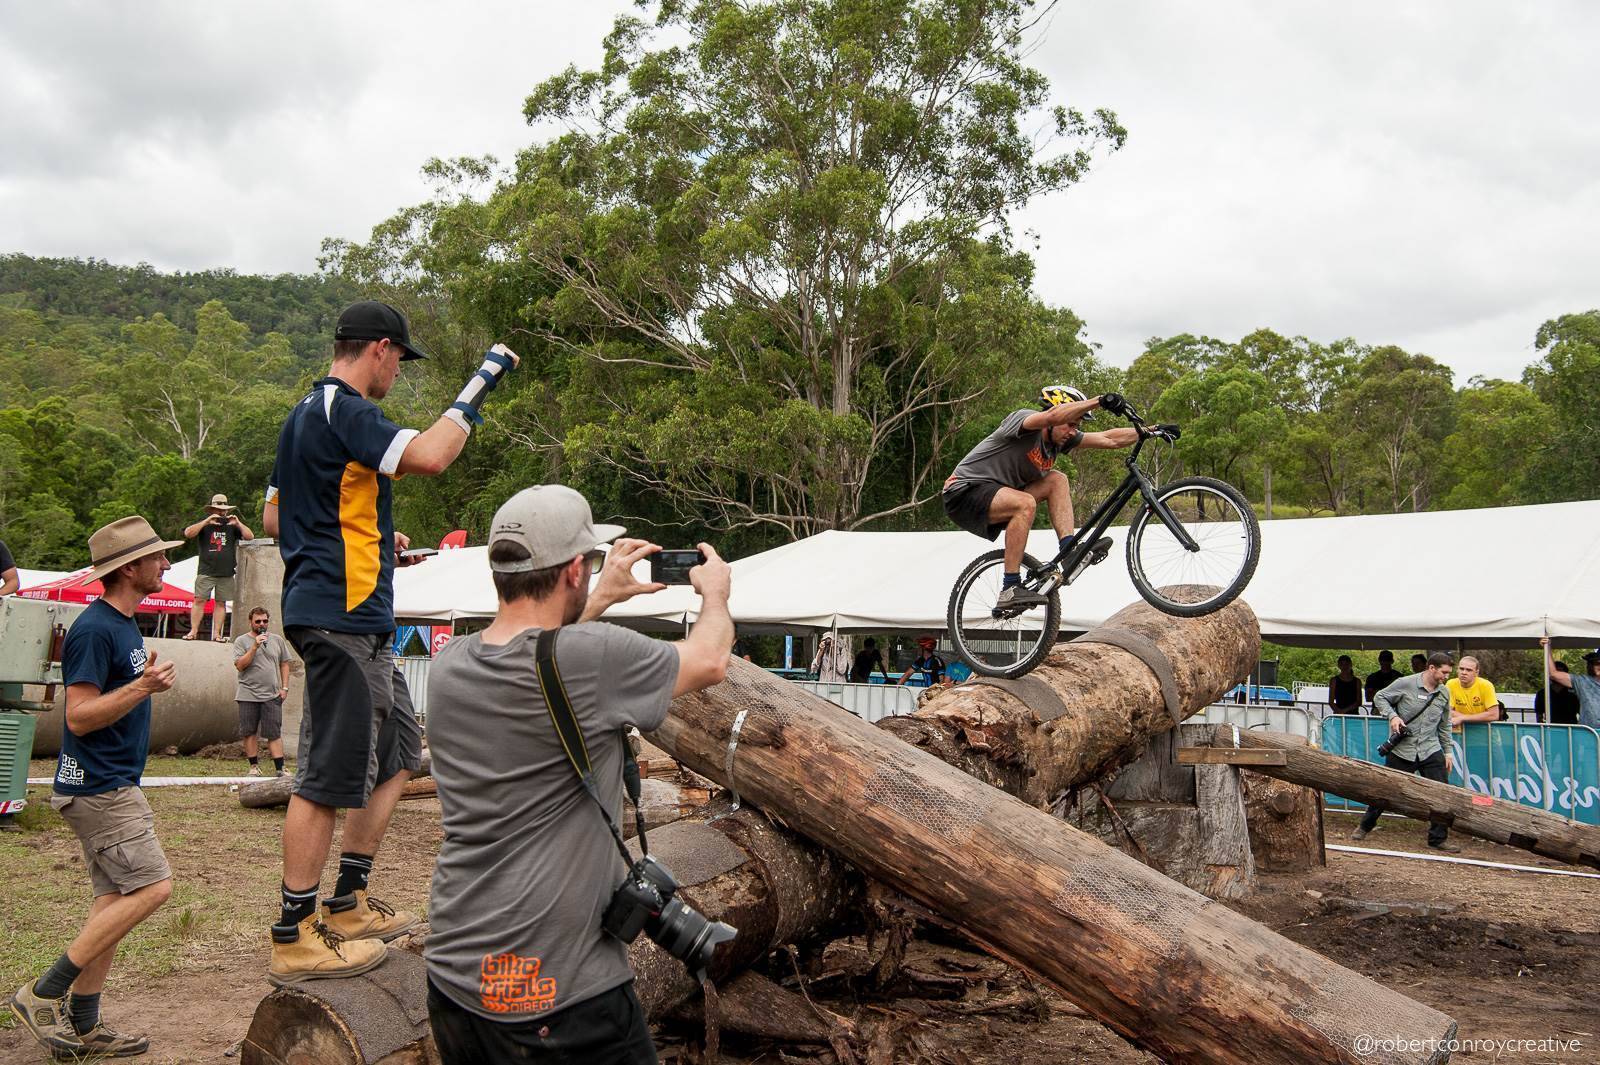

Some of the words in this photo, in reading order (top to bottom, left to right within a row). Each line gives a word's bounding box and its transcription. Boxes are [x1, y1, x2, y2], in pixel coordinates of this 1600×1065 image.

[481, 953, 541, 978] bike
[480, 975, 557, 1002] trials
[510, 999, 555, 1013] DIRECT
